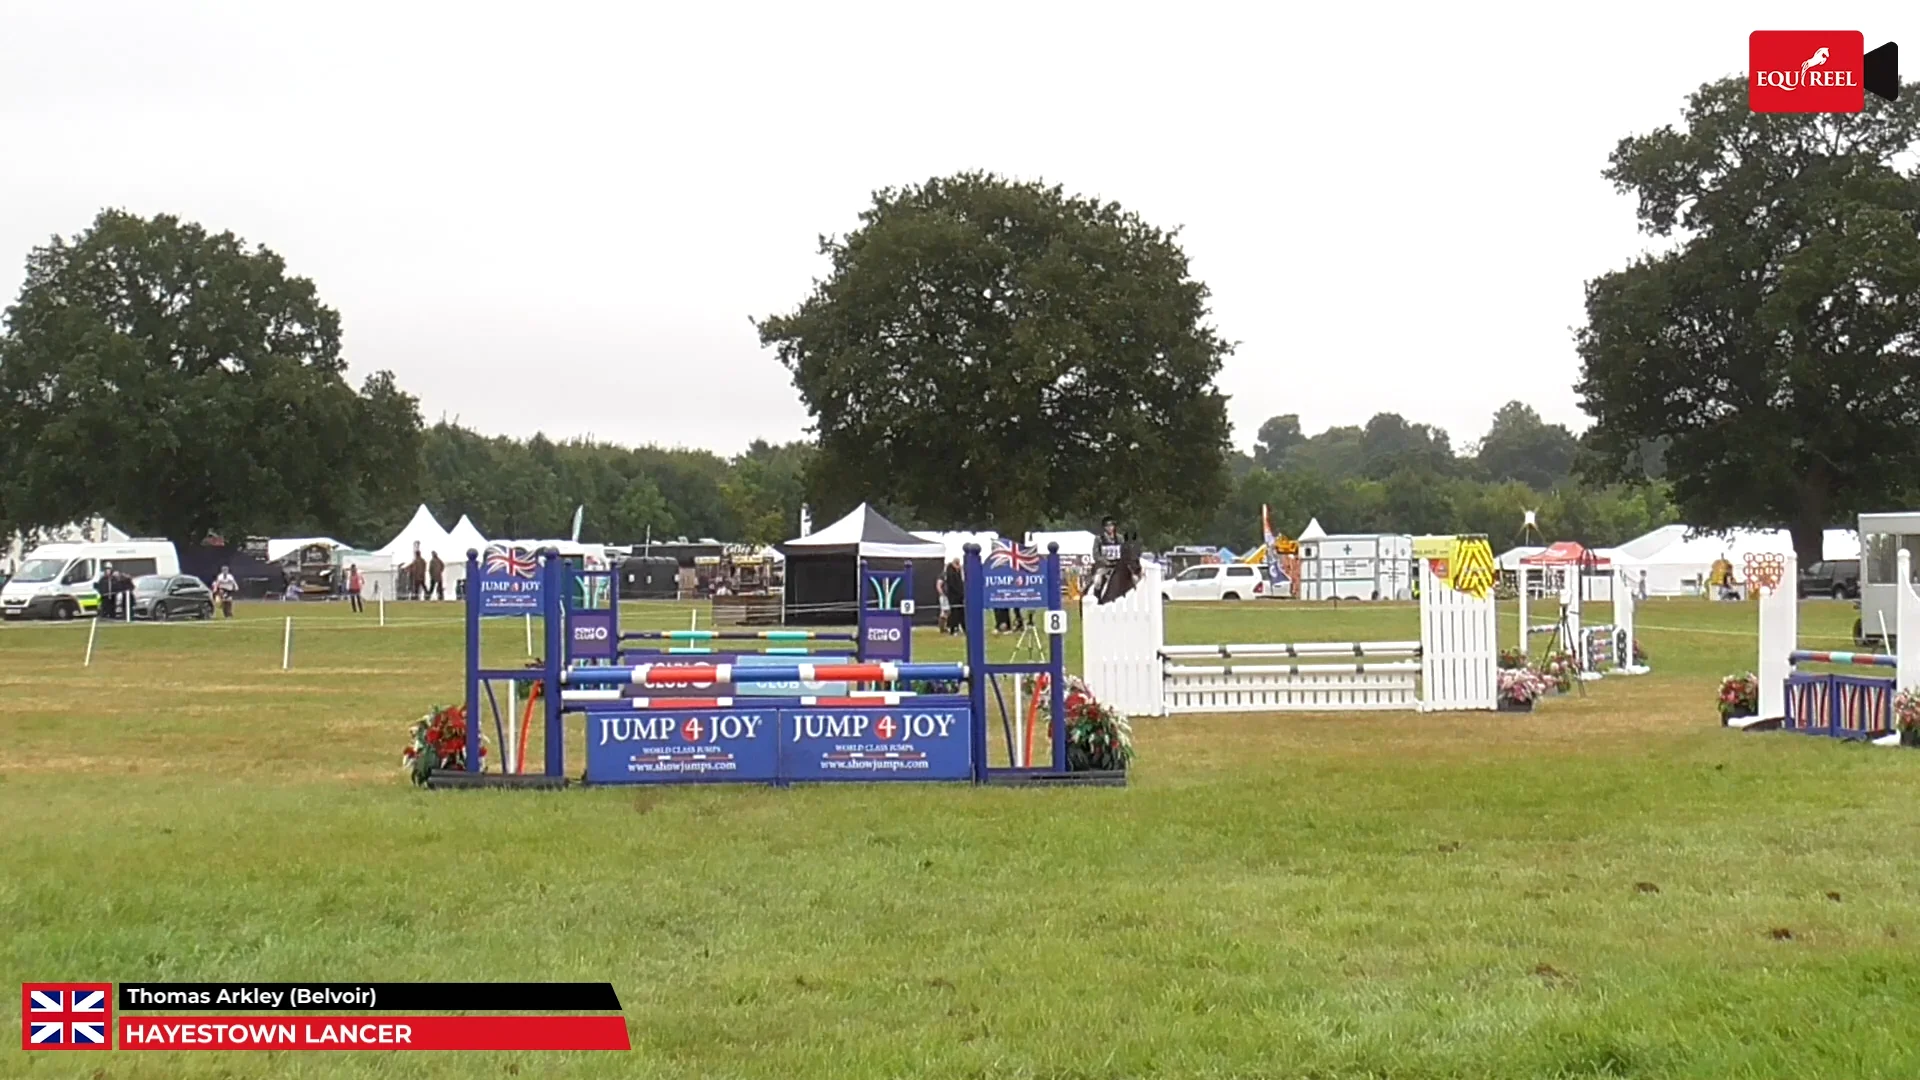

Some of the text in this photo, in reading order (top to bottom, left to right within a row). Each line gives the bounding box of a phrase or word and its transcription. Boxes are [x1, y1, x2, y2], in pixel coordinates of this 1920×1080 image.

[481, 581, 510, 592] JUMP
[521, 581, 540, 592] JOY
[986, 575, 1014, 587] JUMP
[1025, 574, 1045, 586] JOY
[904, 602, 911, 613] 9
[1050, 613, 1060, 630] 8
[600, 717, 676, 745] JUMP
[683, 717, 703, 741] 4
[792, 715, 869, 742] JUMP
[878, 715, 897, 738] 4
[628, 761, 736, 773] www.showjumps.com
[820, 759, 928, 771] www.showjumps.com
